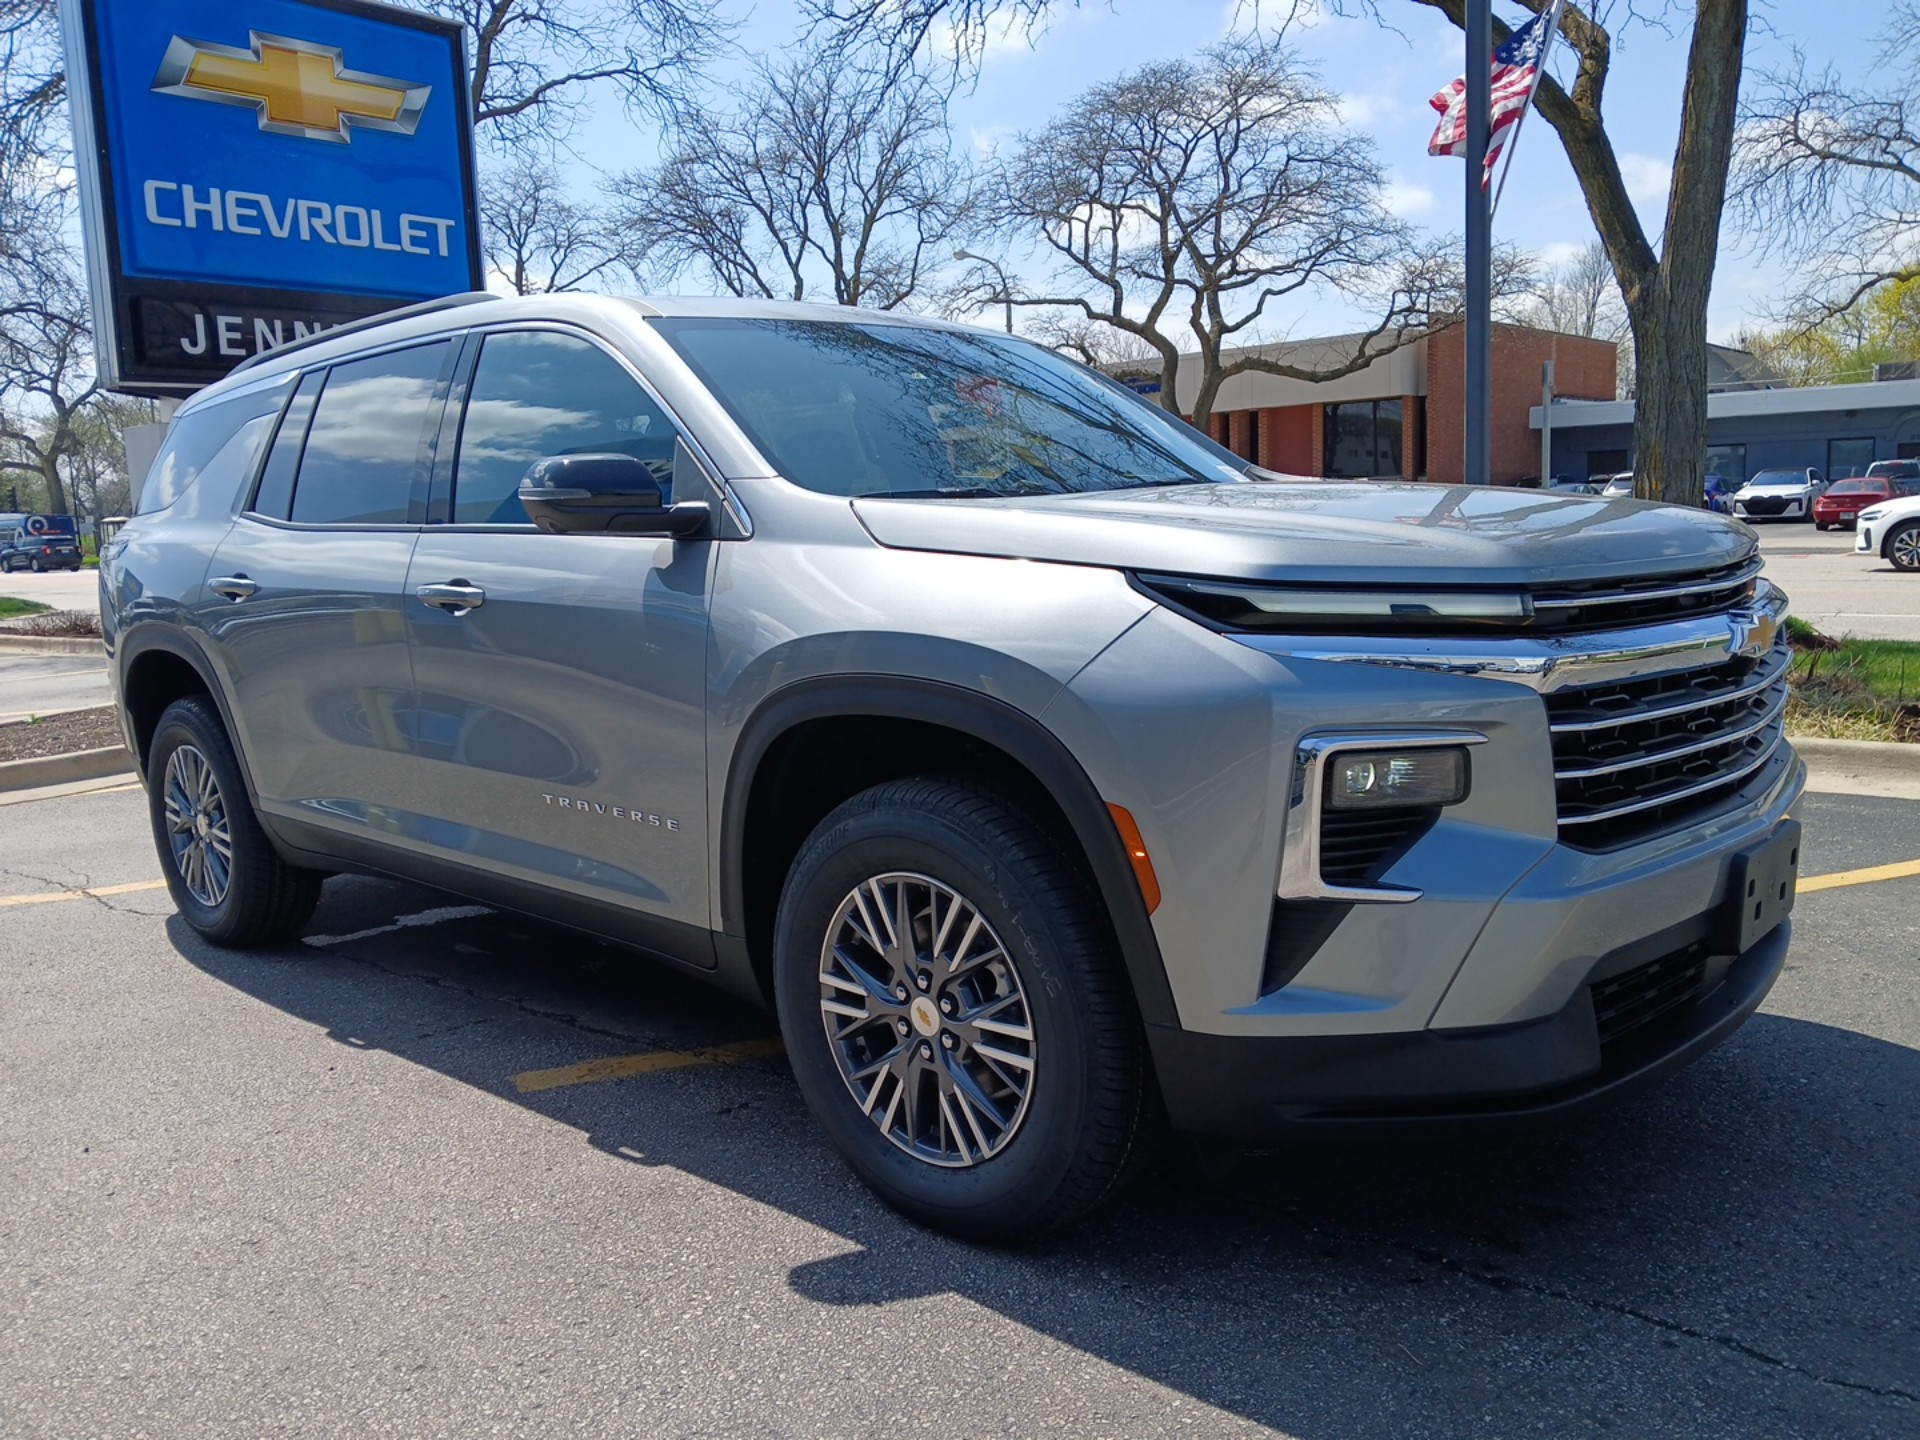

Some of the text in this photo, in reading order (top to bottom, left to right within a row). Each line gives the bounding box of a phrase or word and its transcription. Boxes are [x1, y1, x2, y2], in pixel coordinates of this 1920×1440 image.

[143, 179, 455, 257] CHEVROLET
[180, 313, 343, 355] JEN
[542, 793, 680, 832] TRAVERSE
